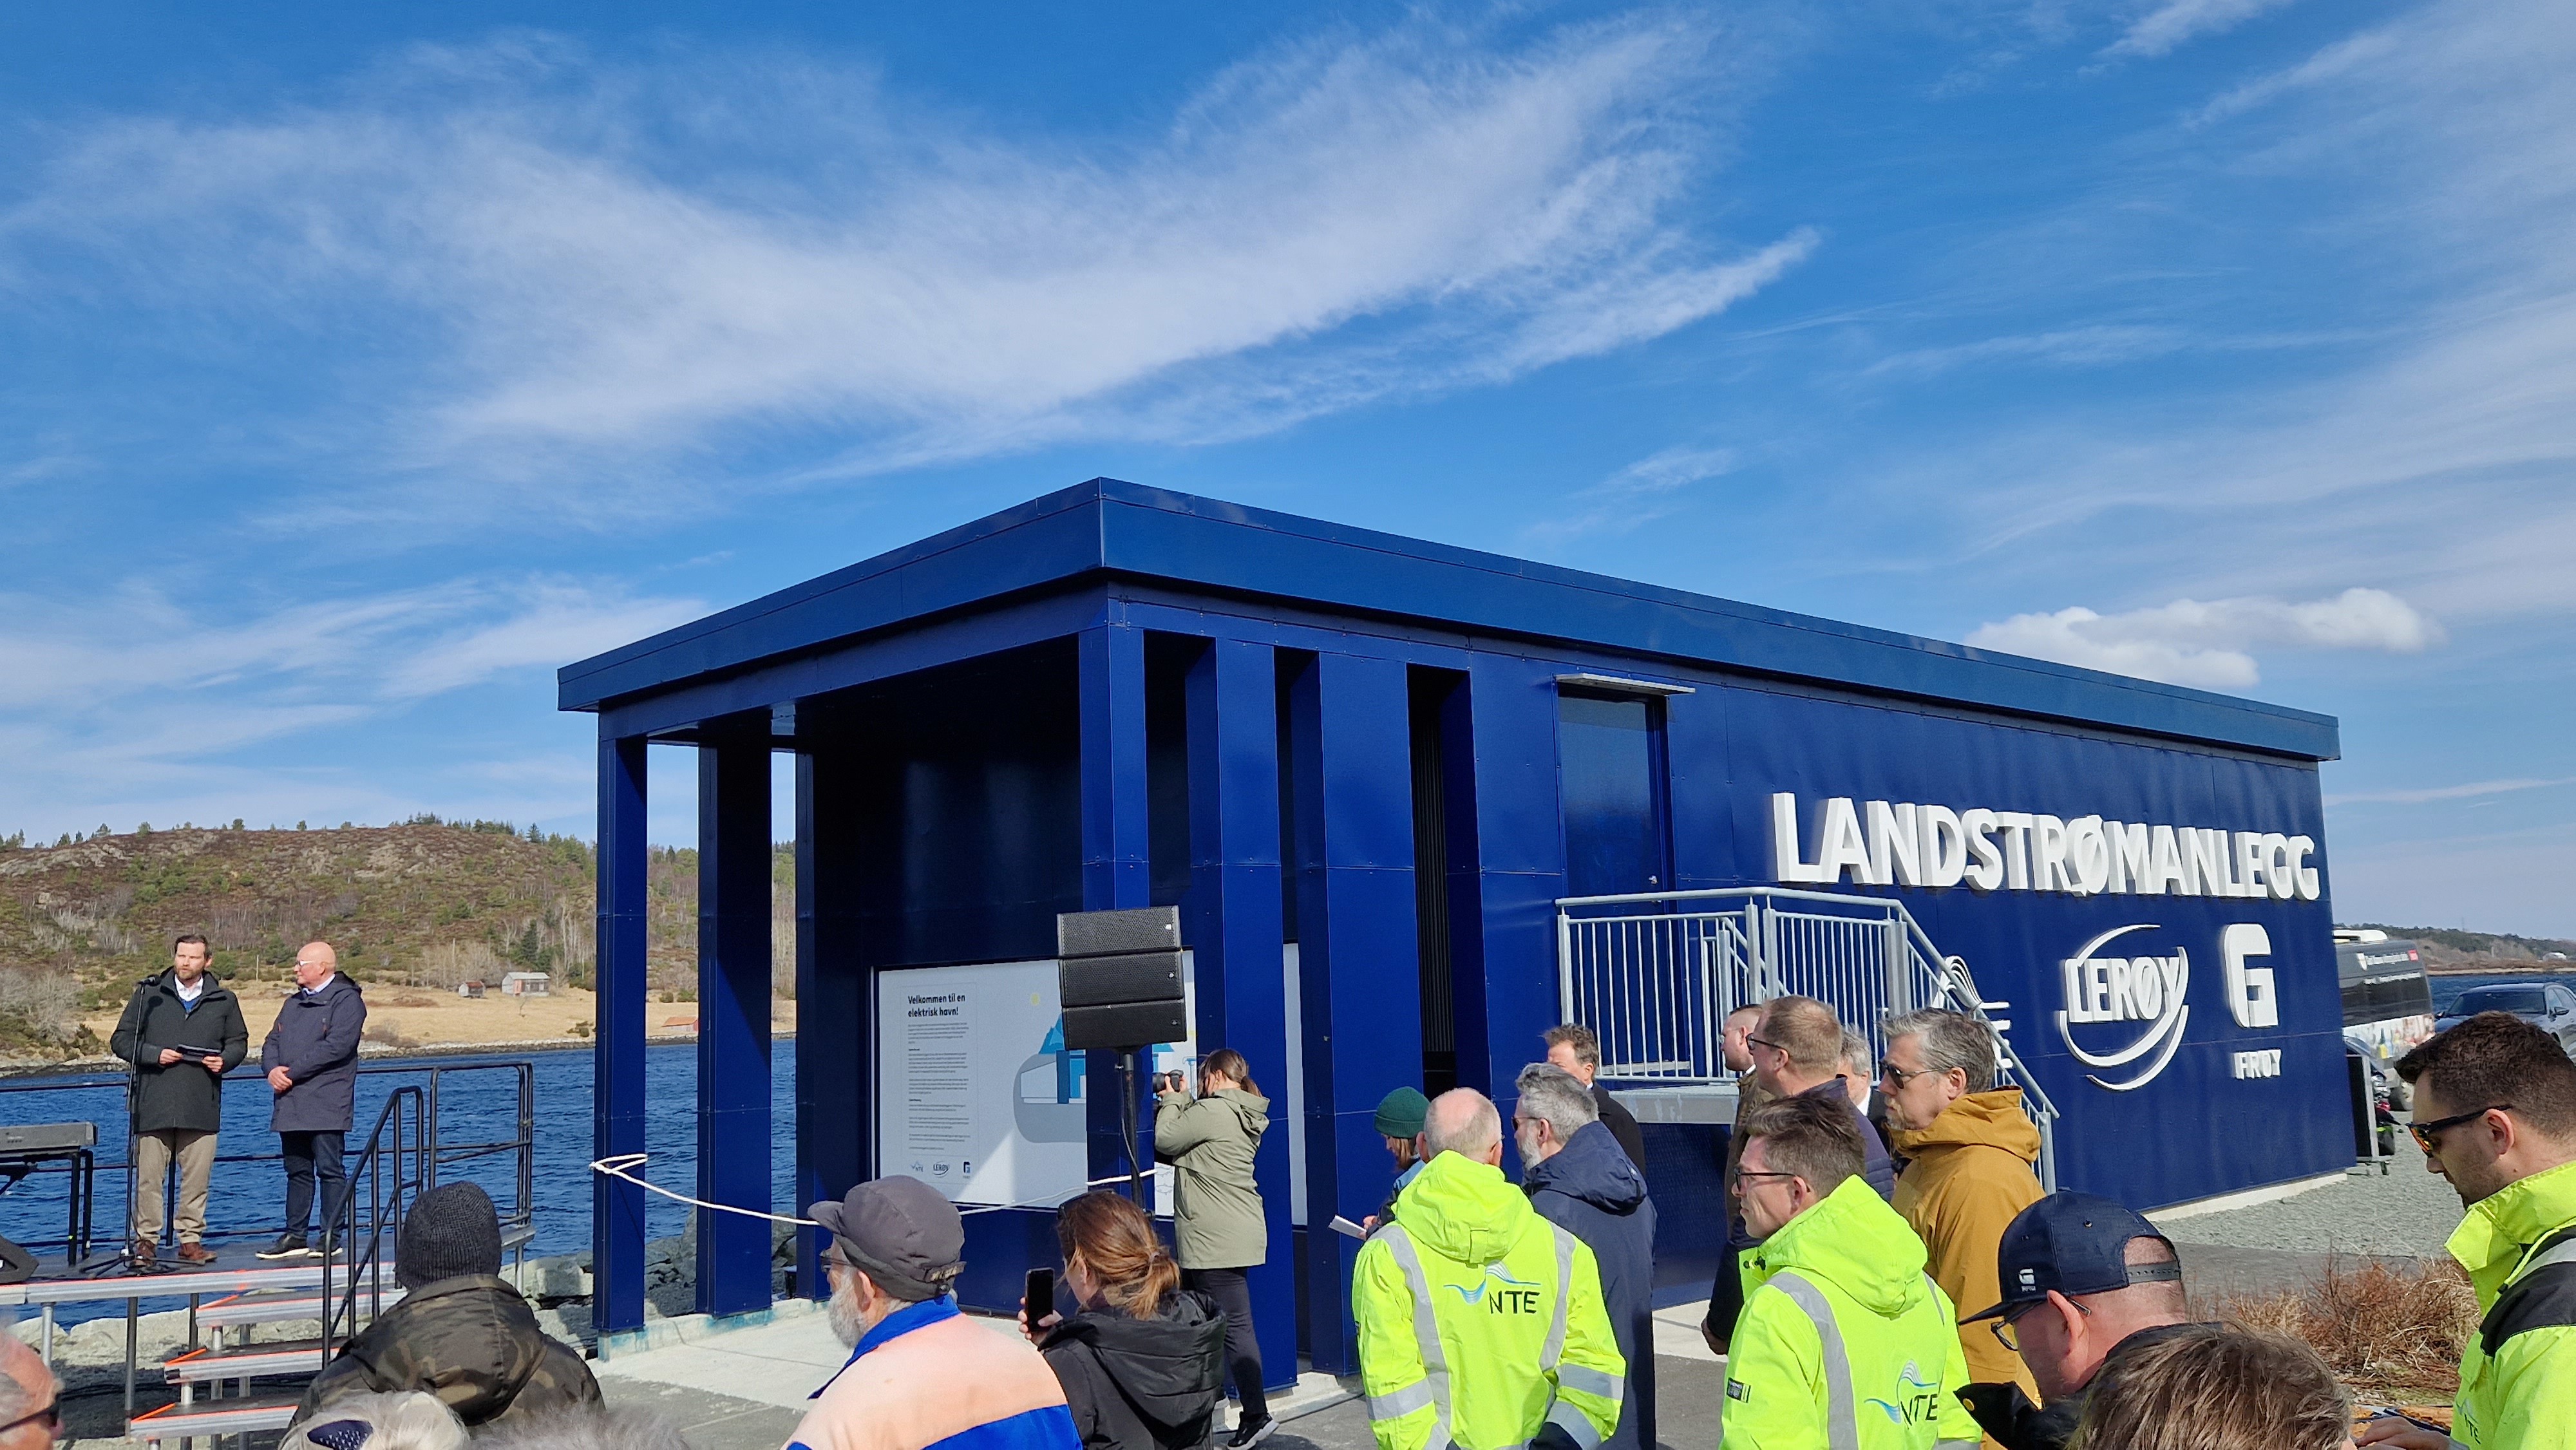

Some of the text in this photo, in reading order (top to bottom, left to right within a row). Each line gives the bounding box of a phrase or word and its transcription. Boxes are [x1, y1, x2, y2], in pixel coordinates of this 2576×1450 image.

[1772, 792, 2320, 900] LANDSTRØMANLEGG
[908, 995, 947, 1004] Velkommen
[2065, 957, 2182, 1023] LERØY
[908, 1006, 959, 1017] elektrisk havn!
[1489, 1290, 1540, 1314] NTE
